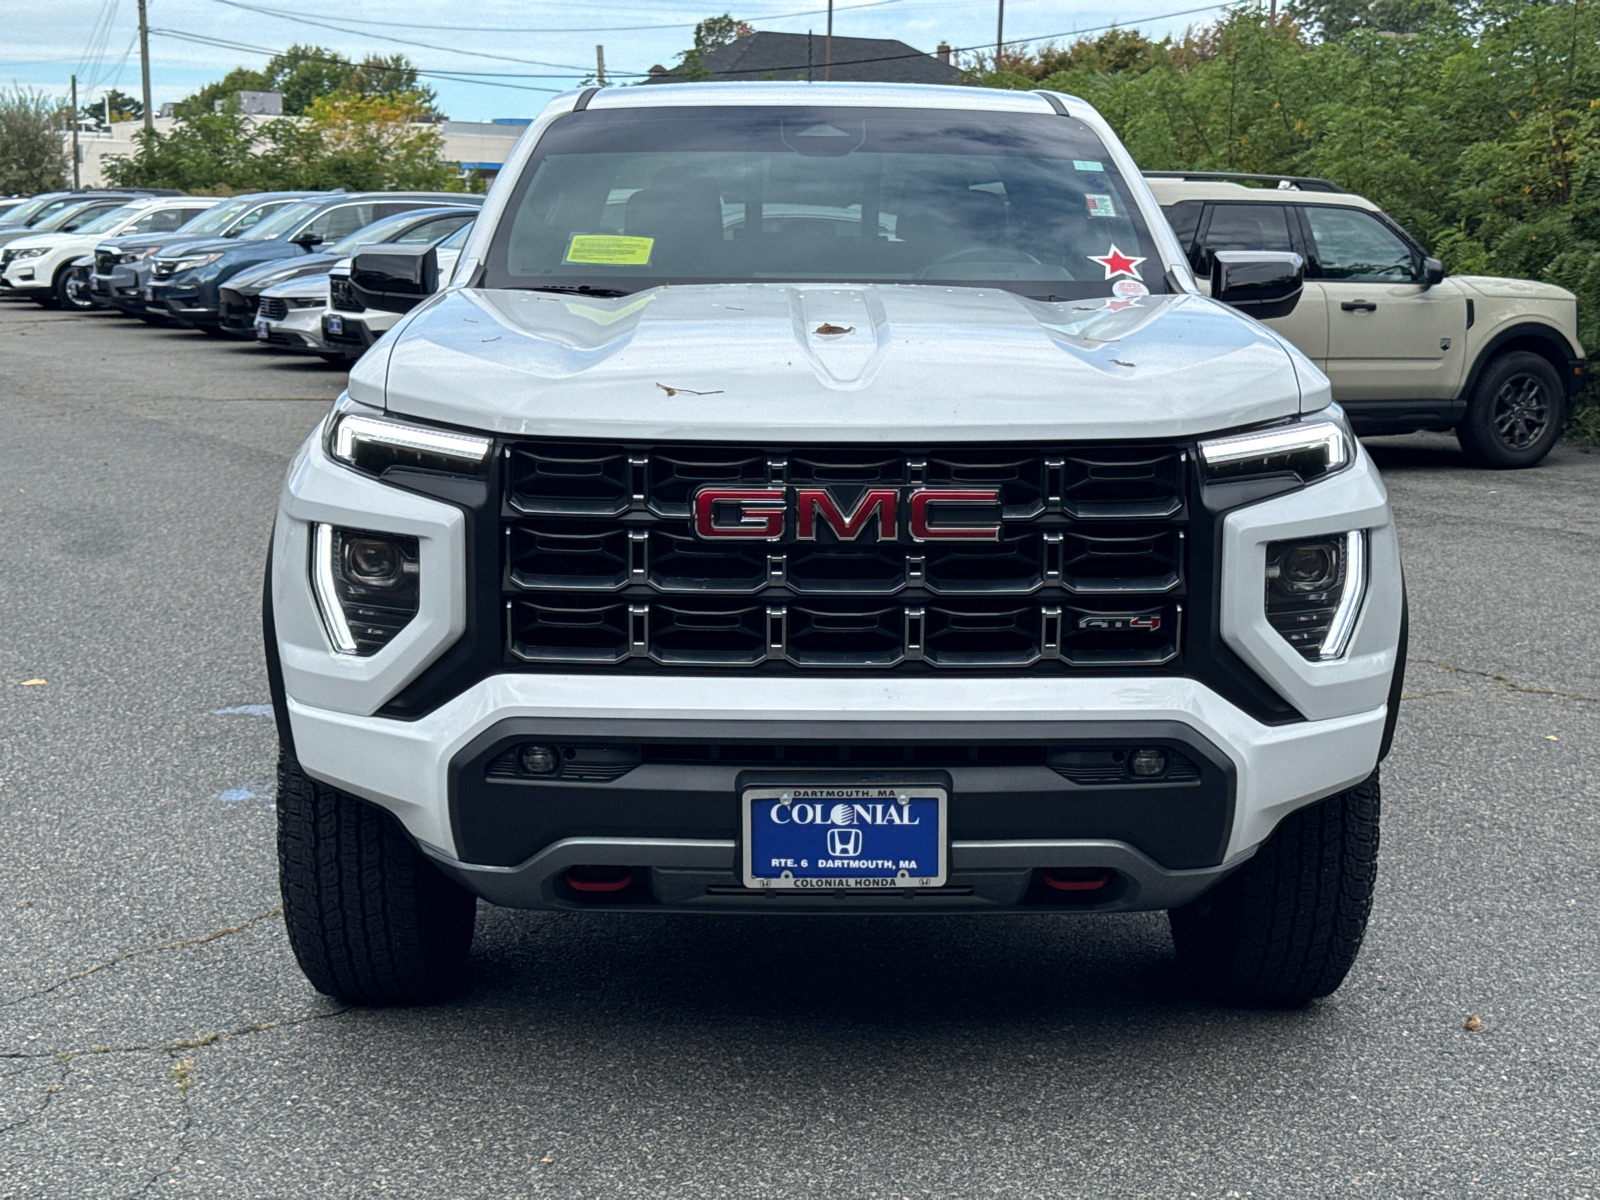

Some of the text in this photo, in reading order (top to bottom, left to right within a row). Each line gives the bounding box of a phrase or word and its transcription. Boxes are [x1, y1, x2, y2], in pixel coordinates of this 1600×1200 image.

[693, 487, 1001, 543] GMC
[1079, 615, 1161, 632] AT4
[793, 790, 873, 798] DARTMOUTH,
[770, 803, 920, 826] COLONIAL
[771, 858, 917, 870] RTE. 6 DARTMOUTH, MA
[793, 879, 897, 888] COLONIAL HONDA
